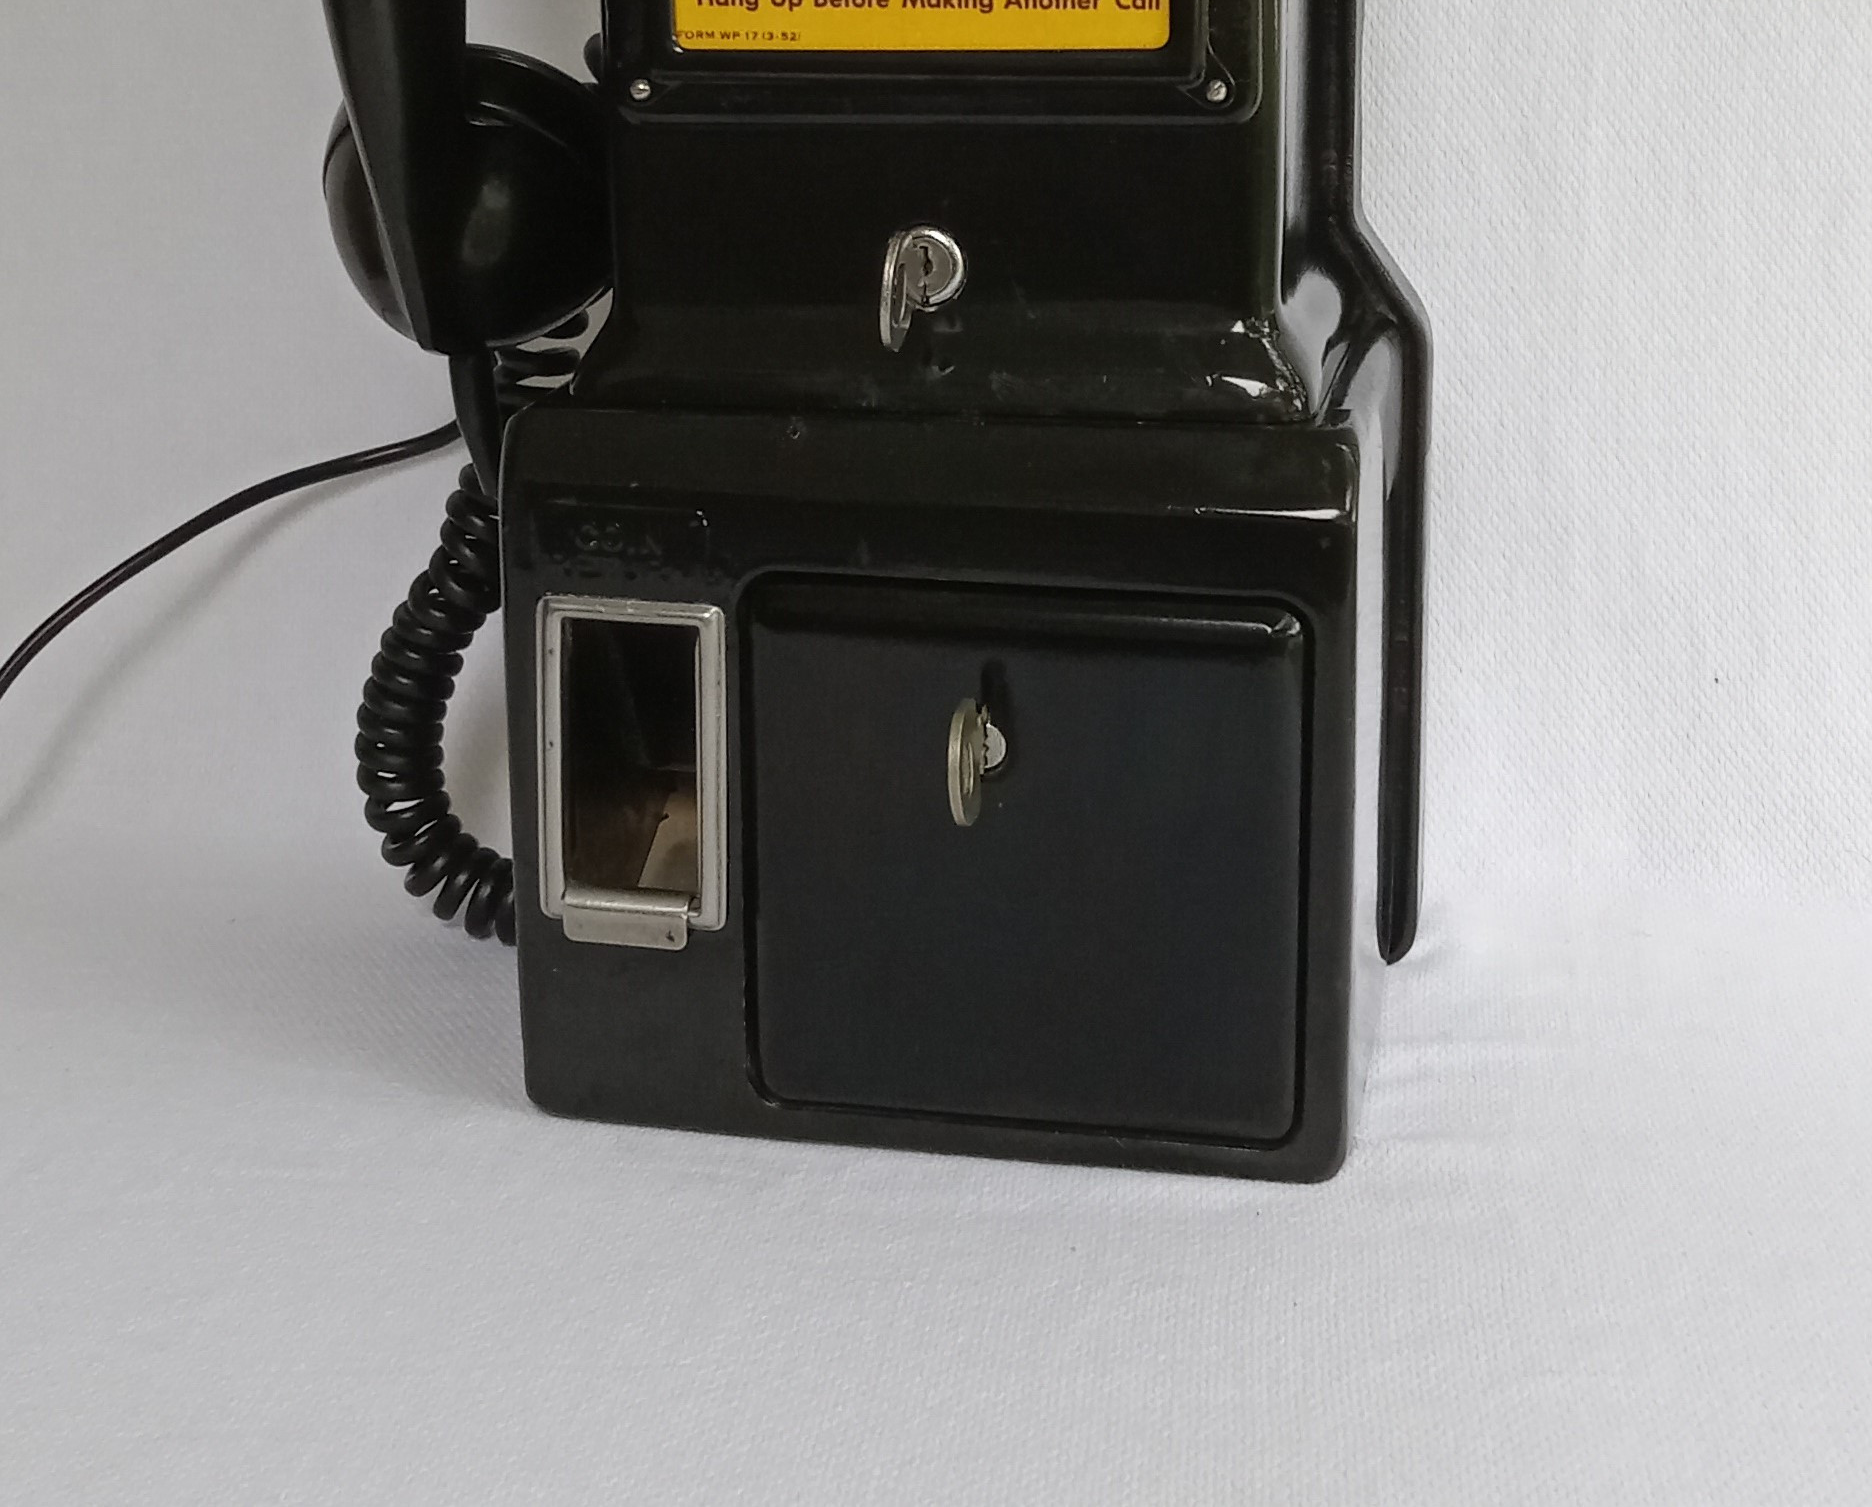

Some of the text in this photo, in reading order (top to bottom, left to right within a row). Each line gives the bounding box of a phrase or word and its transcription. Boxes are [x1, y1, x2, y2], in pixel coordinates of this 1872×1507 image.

[677, 30, 715, 40] FORM
[720, 30, 740, 40] WP
[745, 31, 758, 40] 17
